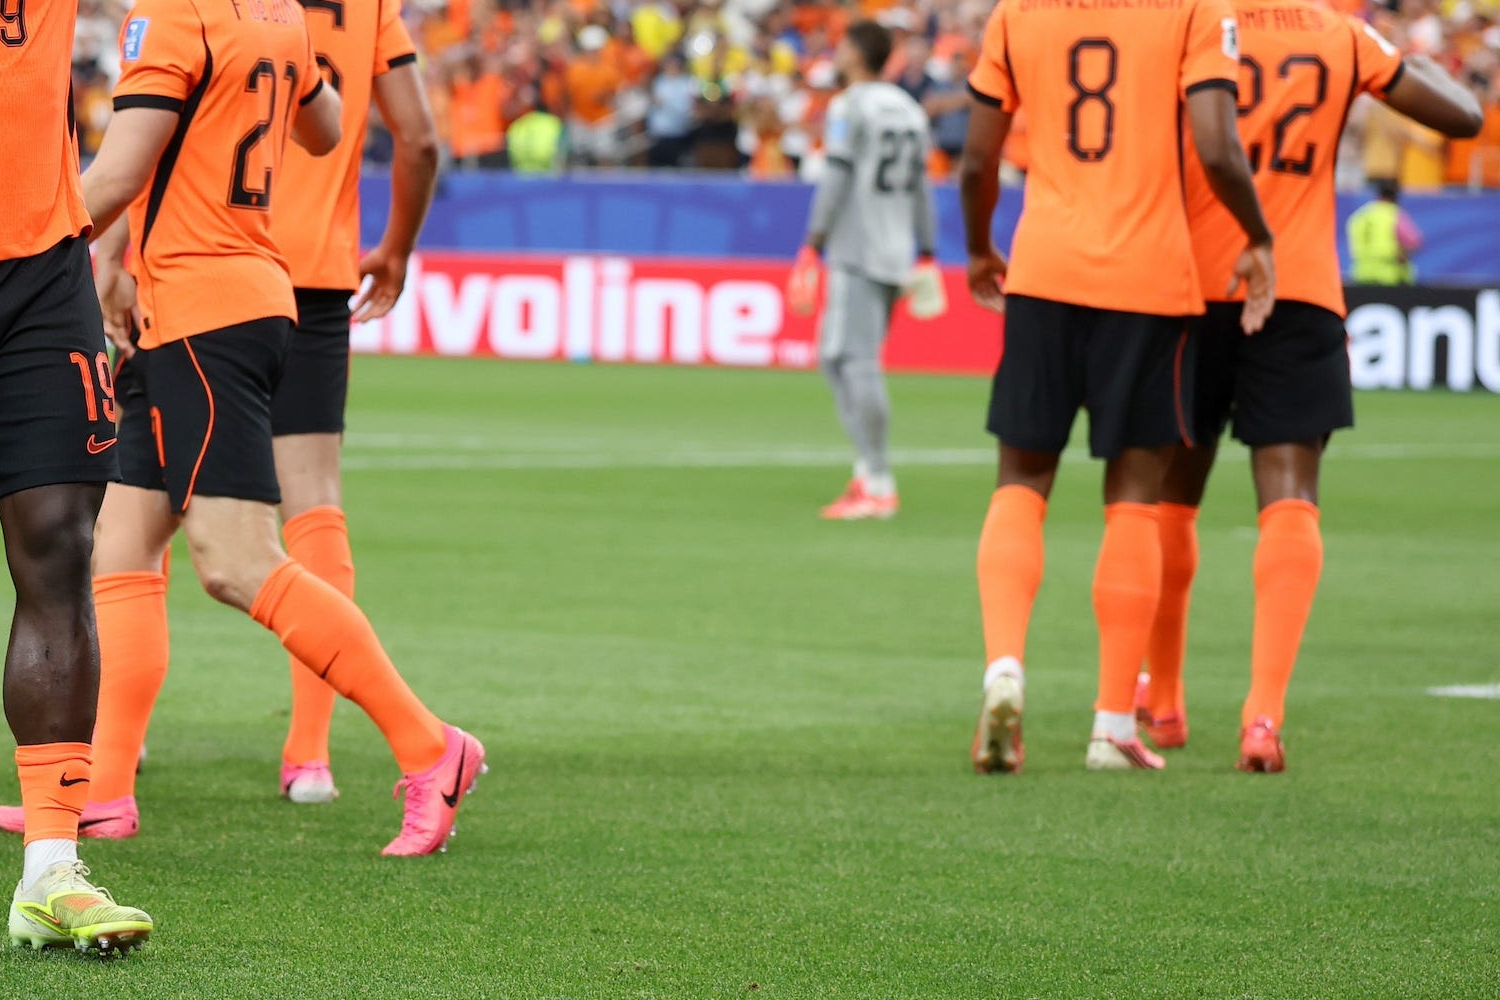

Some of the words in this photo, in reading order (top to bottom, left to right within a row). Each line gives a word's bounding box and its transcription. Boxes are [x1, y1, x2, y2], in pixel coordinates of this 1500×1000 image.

[227, 57, 299, 212] 21
[1067, 36, 1118, 162] 8
[69, 351, 117, 423] 19
